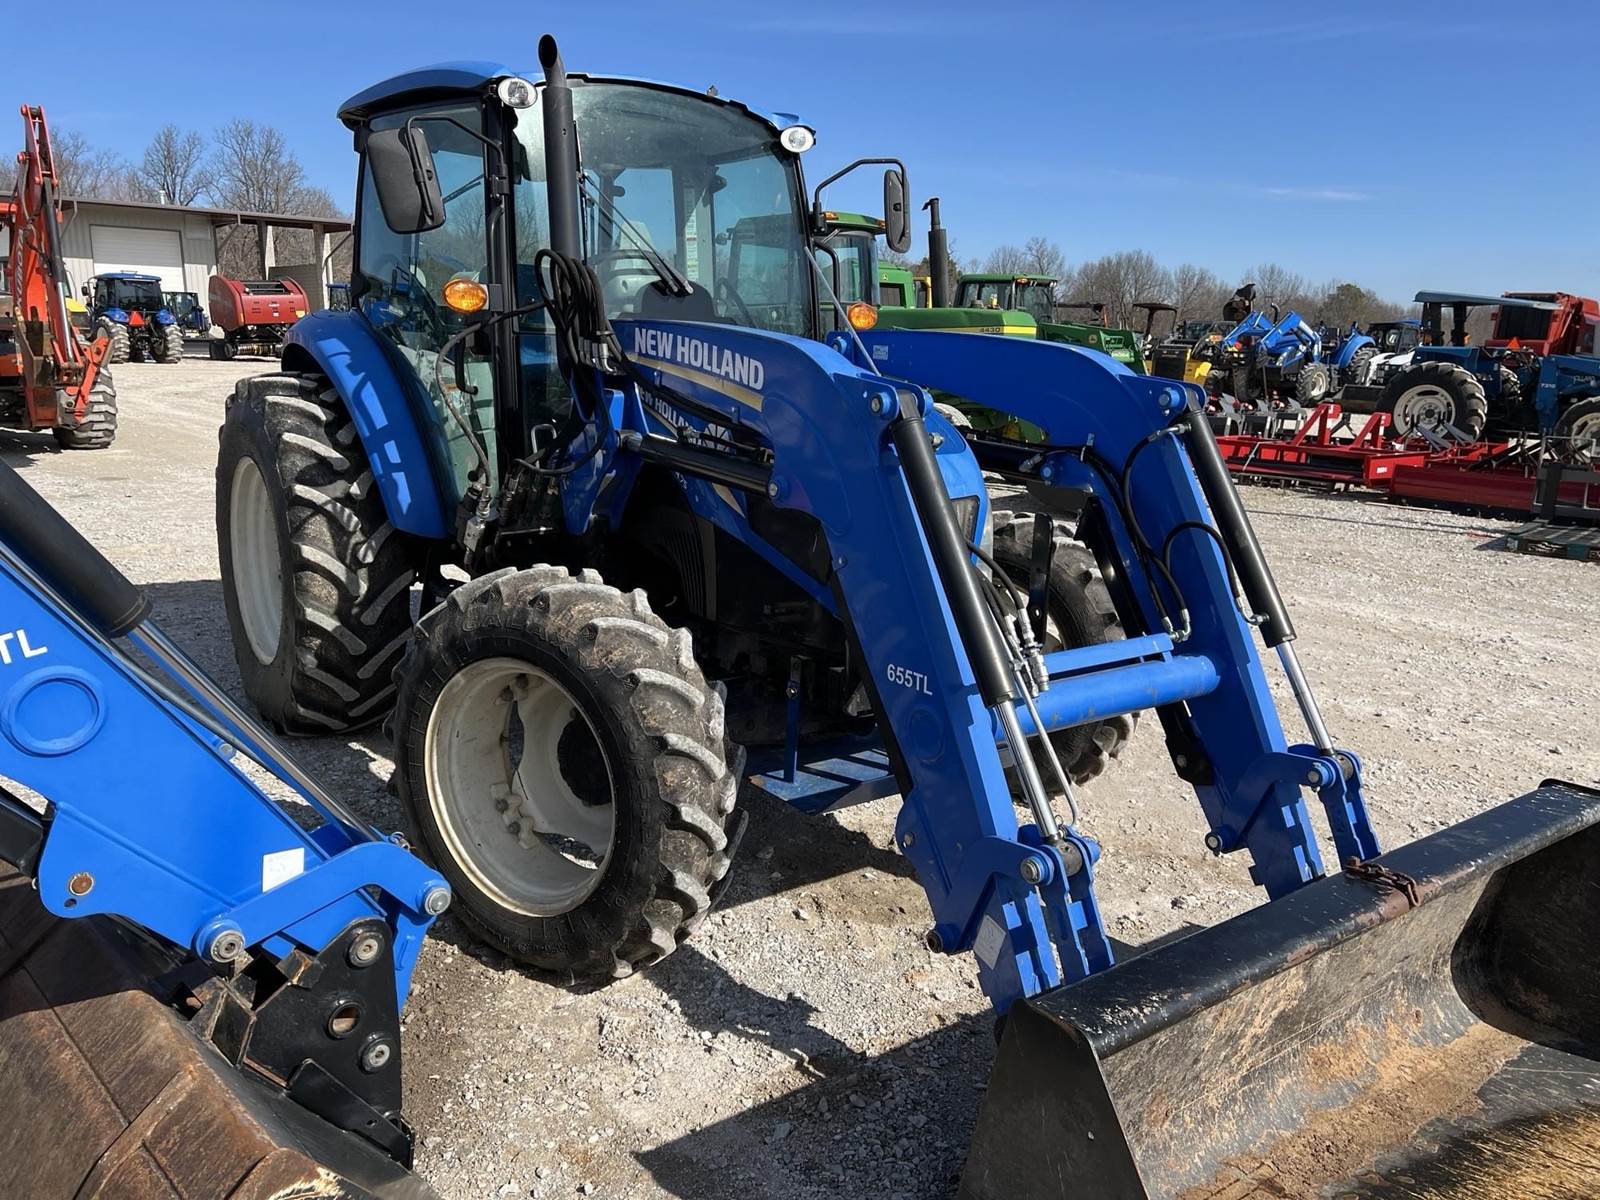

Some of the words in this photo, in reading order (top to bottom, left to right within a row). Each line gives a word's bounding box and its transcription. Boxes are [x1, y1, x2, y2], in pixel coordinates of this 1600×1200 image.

[634, 327, 674, 359] NEW
[676, 335, 765, 391] HOLLAND
[887, 663, 933, 696] 655TL
